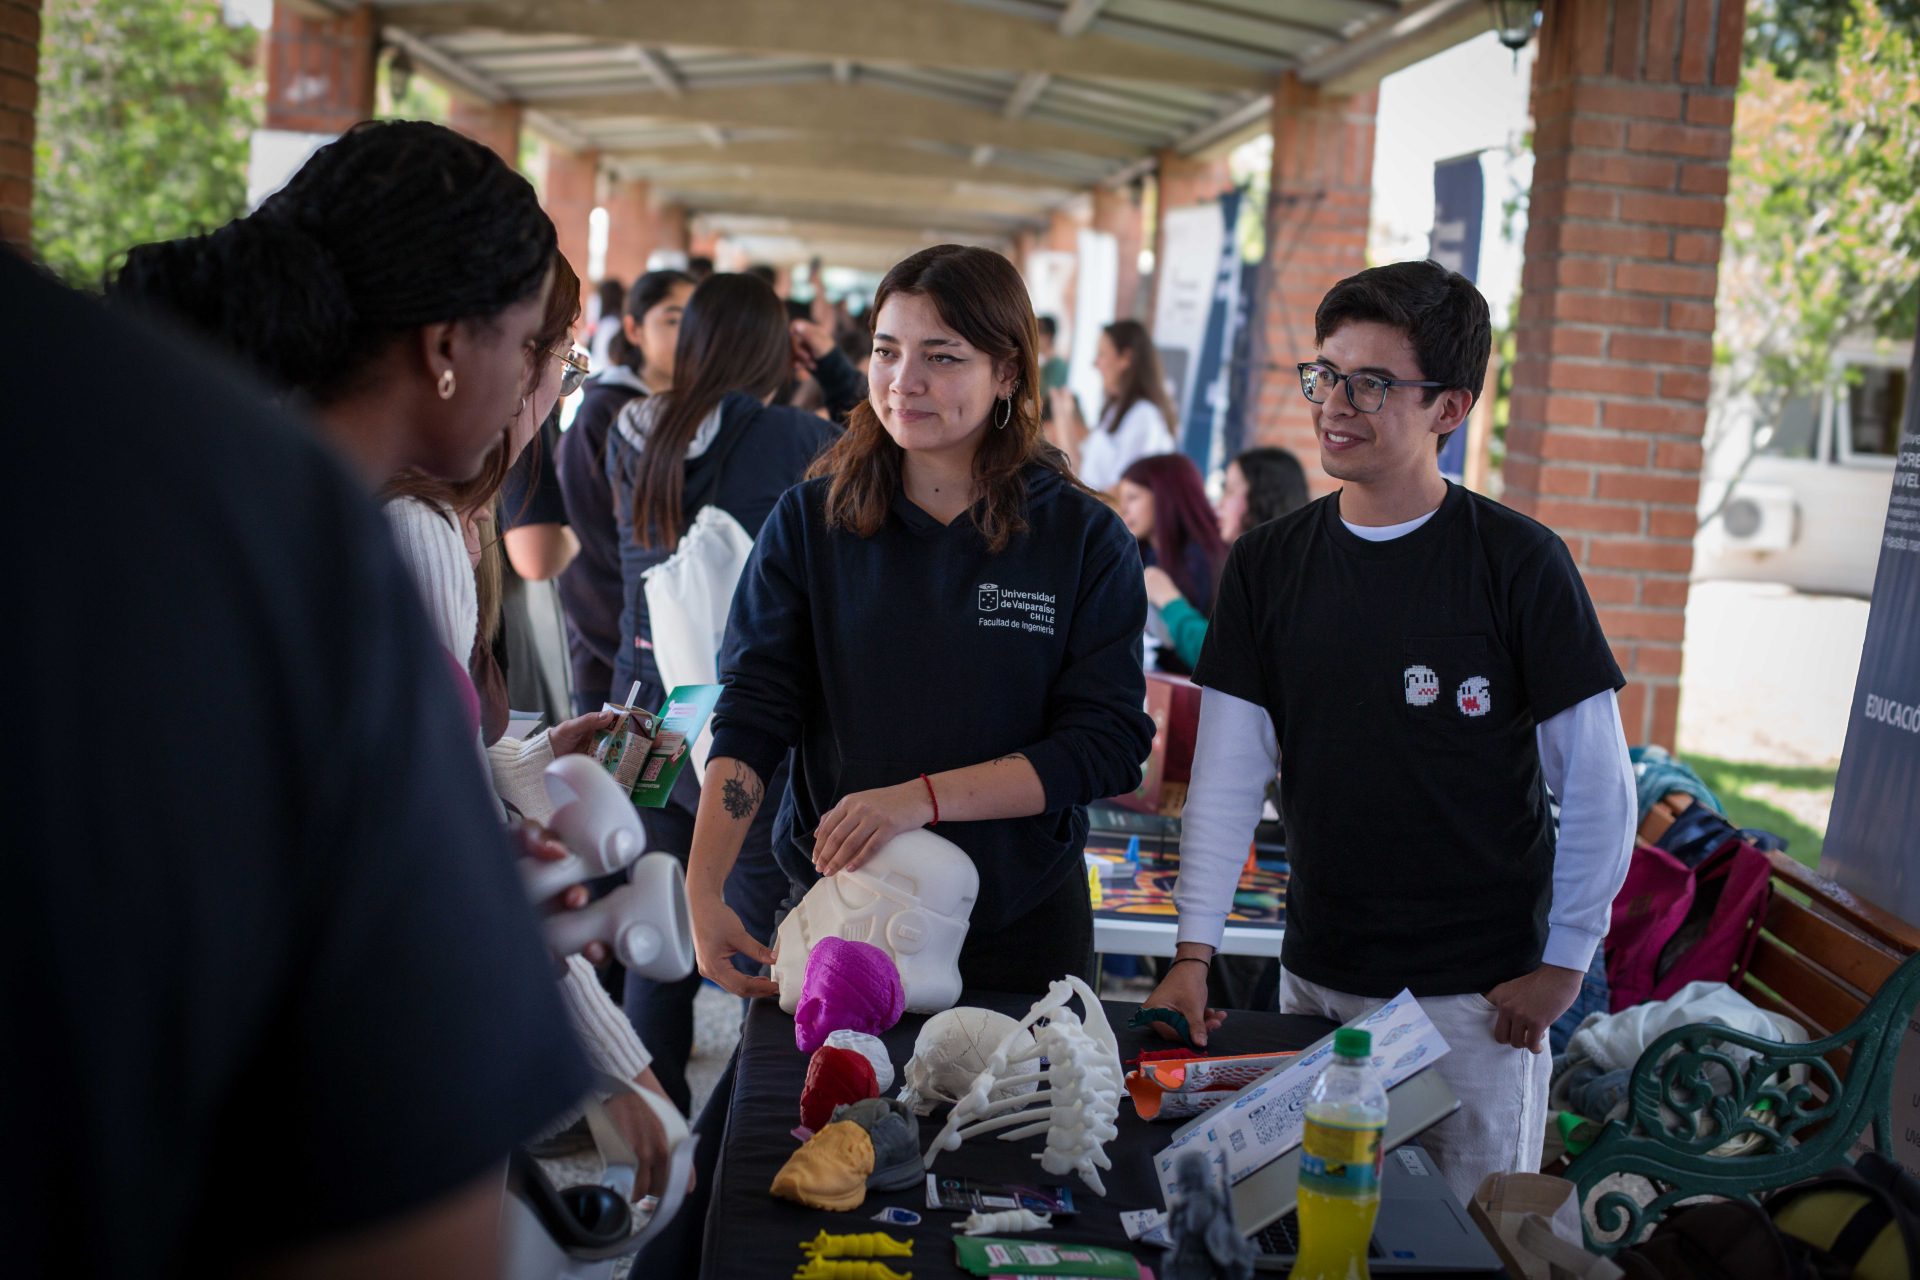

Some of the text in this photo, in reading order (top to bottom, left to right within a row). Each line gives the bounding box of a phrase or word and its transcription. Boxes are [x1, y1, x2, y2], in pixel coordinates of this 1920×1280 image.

[1001, 589, 1055, 603] Universidad
[1000, 600, 1055, 614] de Valparaíso
[1030, 612, 1055, 623] CHILE
[978, 617, 1054, 635] Facultad de Ingeniería
